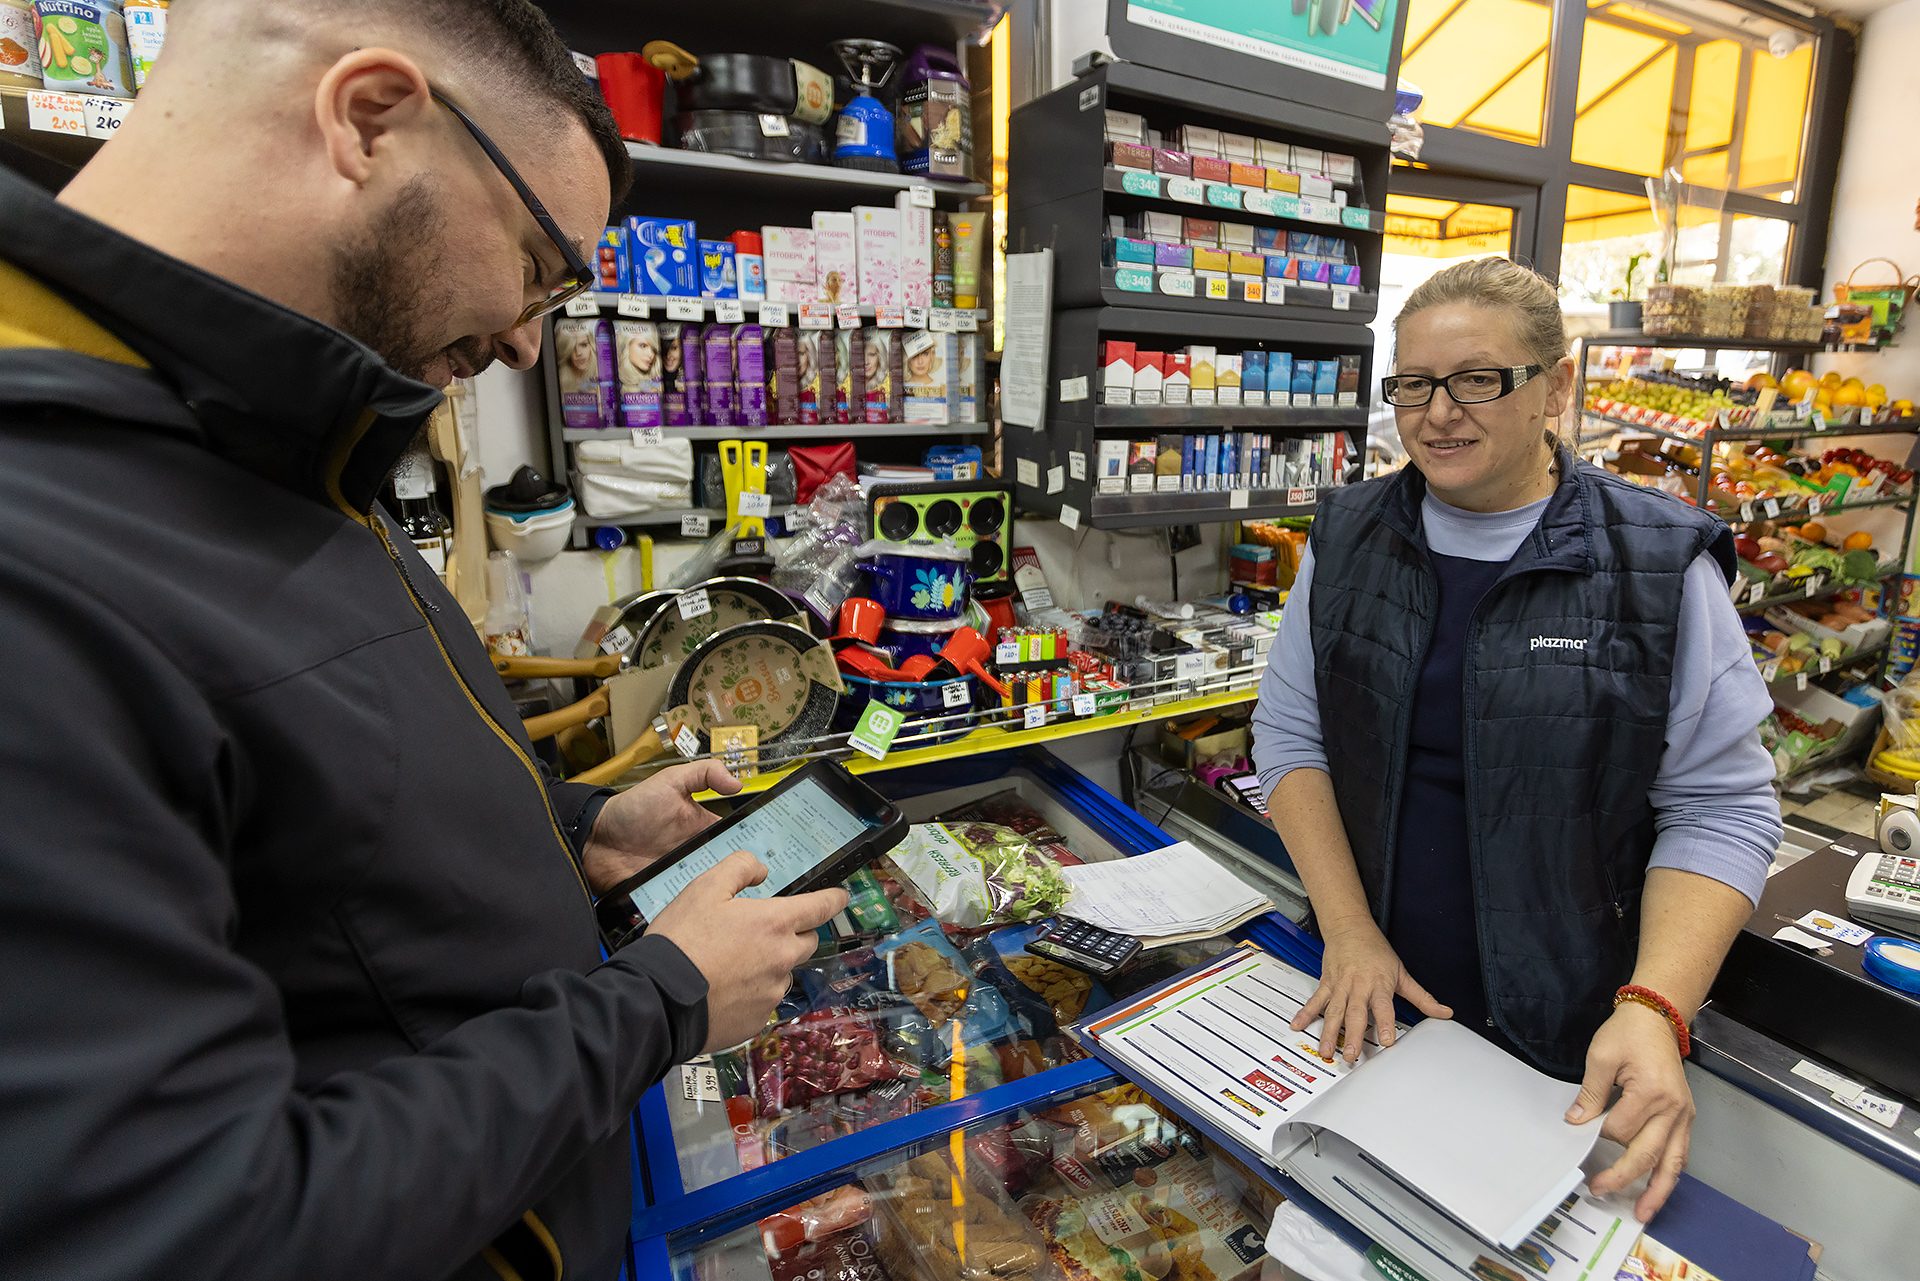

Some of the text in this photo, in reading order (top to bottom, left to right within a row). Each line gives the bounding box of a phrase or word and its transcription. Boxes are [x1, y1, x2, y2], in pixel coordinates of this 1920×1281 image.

[40, 2, 94, 20] Nutrino
[96, 116, 121, 129] 210
[1127, 147, 1151, 158] TEREA
[1206, 162, 1228, 171] TEREA
[1243, 167, 1264, 177] TEREA
[1139, 179, 1158, 191] 340
[1183, 186, 1201, 197] 340
[1221, 191, 1239, 202] 340
[1284, 202, 1299, 213] 340
[1323, 207, 1338, 217] 340
[1354, 213, 1368, 223] 340
[817, 230, 850, 239] FITODEPIL
[863, 228, 898, 239] FITODEPIL
[1130, 242, 1152, 253] TEREA
[769, 250, 805, 260] FITODEPIL
[1131, 274, 1151, 286] 340
[1175, 279, 1193, 290] 340
[934, 280, 945, 294] 30
[1210, 281, 1226, 292] 340
[1246, 286, 1261, 296] 340
[622, 324, 649, 333] Palette
[1289, 491, 1303, 501] 350
[1530, 635, 1584, 651] plazma
[1184, 660, 1203, 669] Winston
[923, 823, 949, 845] dobro
[926, 849, 962, 878] REFRESH
[705, 1070, 718, 1093] 399-
[1078, 1118, 1091, 1138] 1kg
[739, 1136, 756, 1144] SIR
[1128, 1141, 1152, 1163] Prijatno!
[1054, 1156, 1093, 1187] Frikom
[1182, 1157, 1245, 1224] CHICKEN
[1164, 1163, 1231, 1233] NUGGETS
[1103, 1198, 1132, 1234] LASAGNE
[1226, 1236, 1250, 1262] Piletina!
